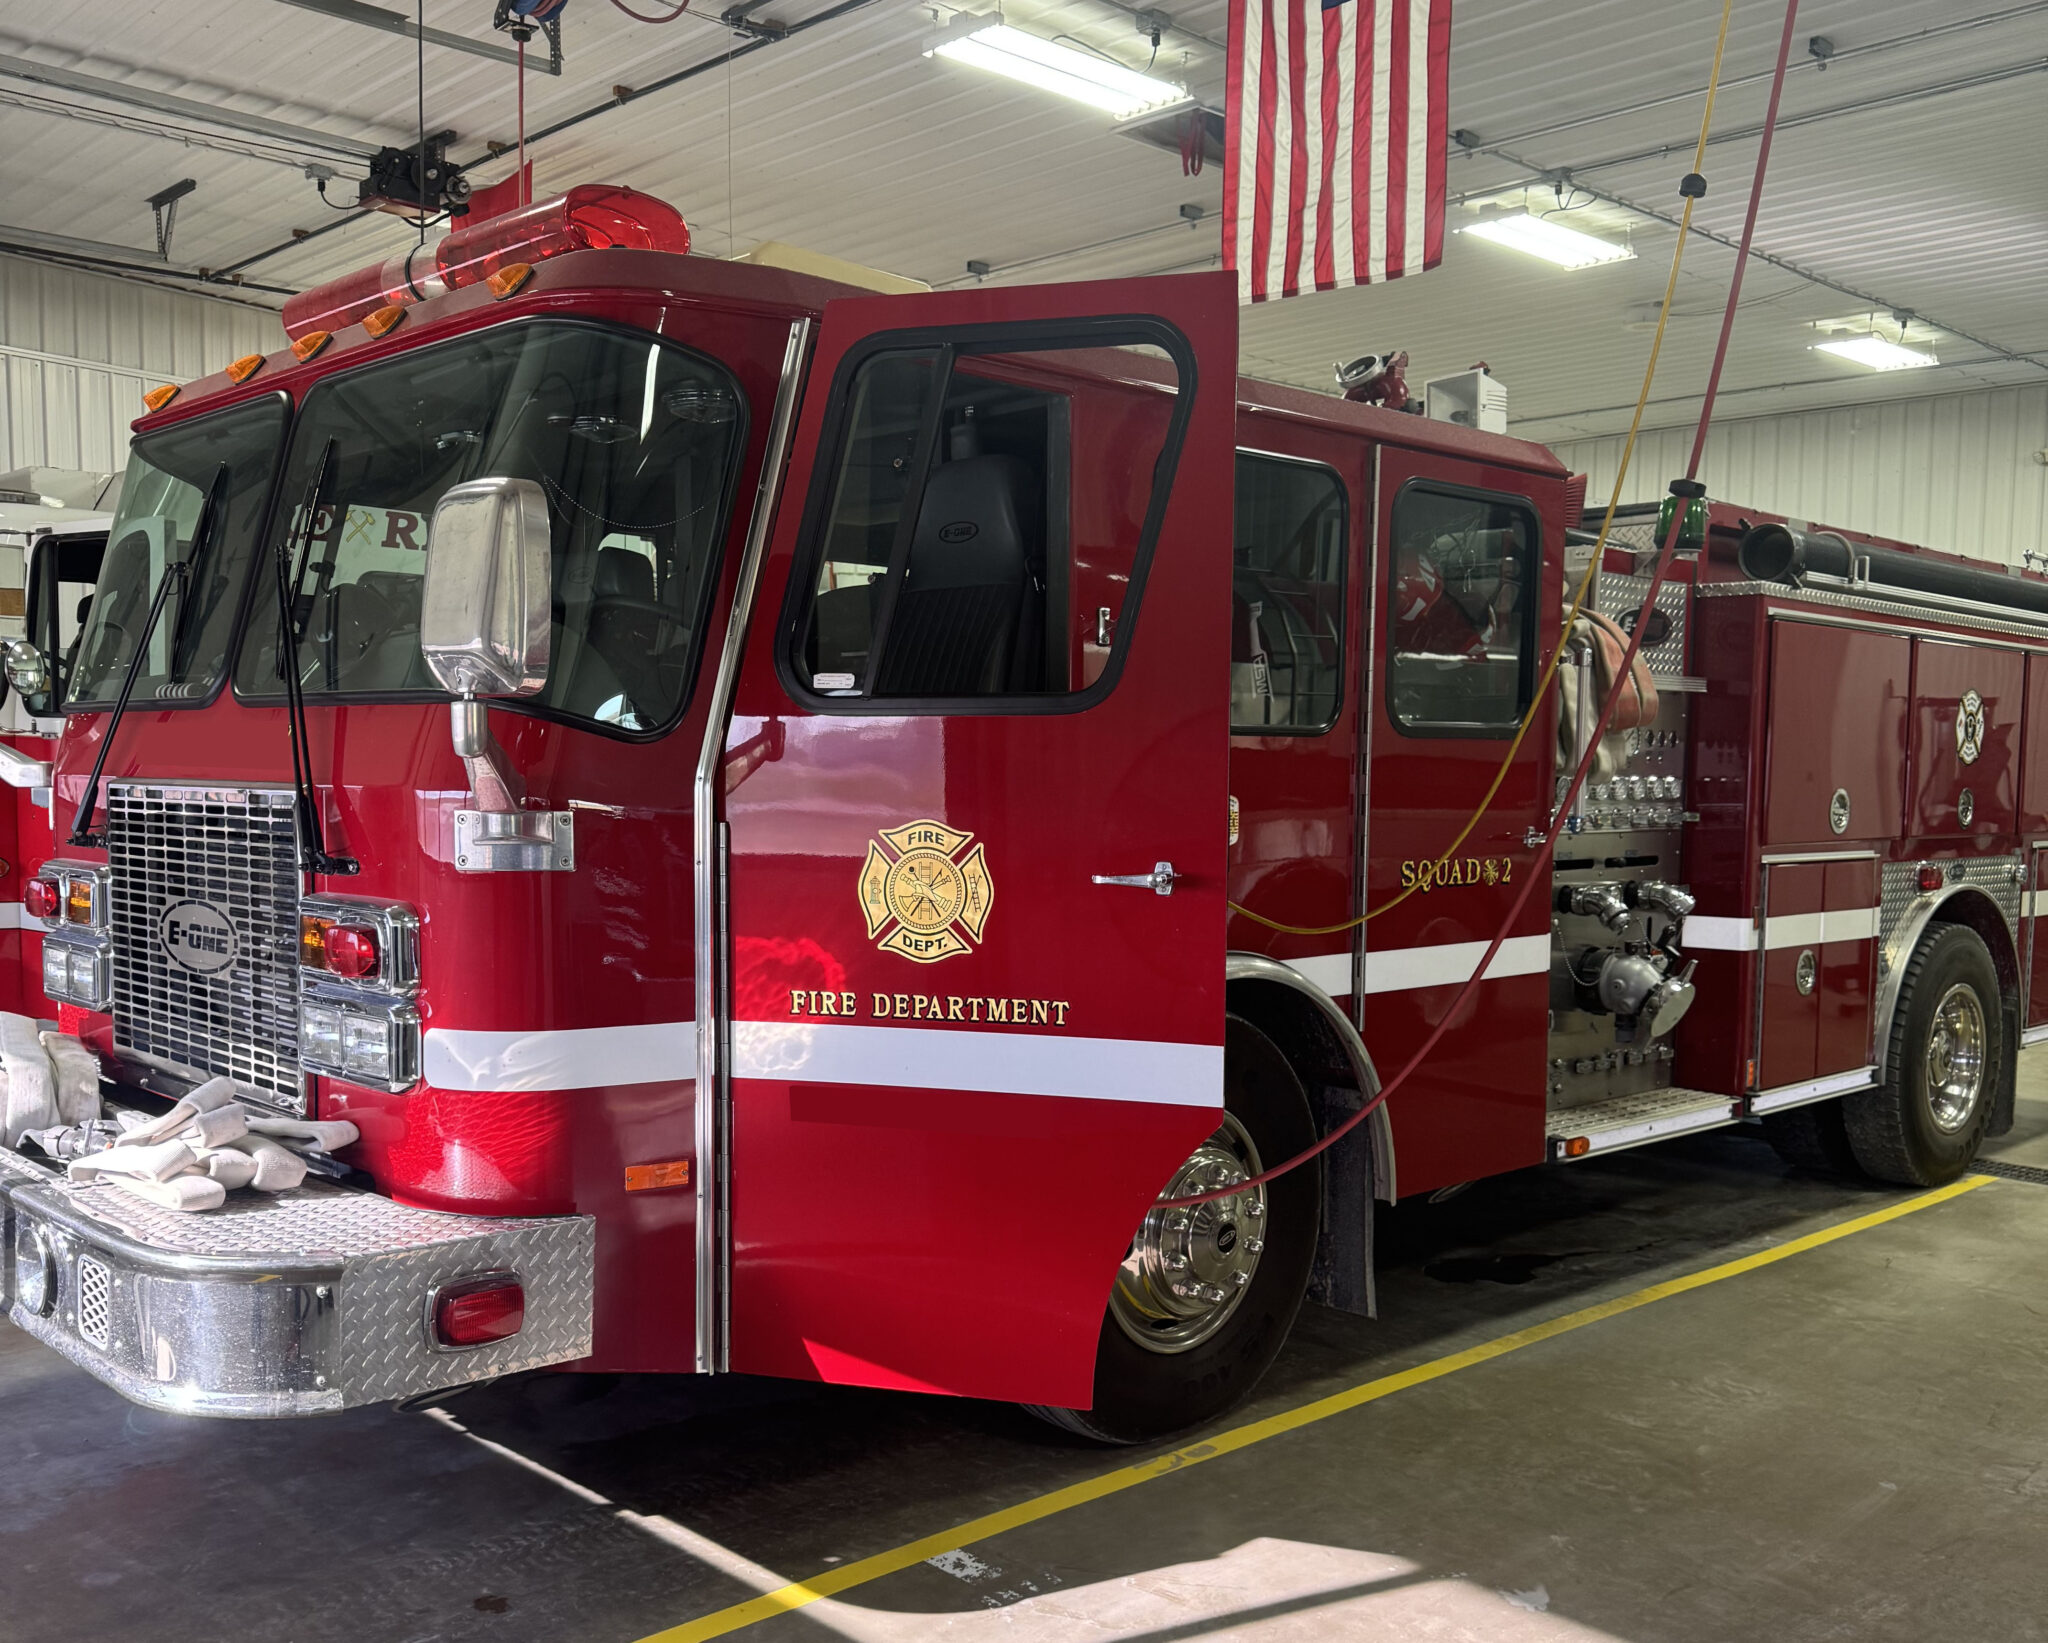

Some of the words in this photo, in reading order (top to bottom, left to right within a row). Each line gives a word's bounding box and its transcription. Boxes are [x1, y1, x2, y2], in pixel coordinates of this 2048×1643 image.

[381, 511, 427, 551] R
[1254, 655, 1268, 695] MSA
[907, 830, 945, 847] FIRE
[1401, 858, 1481, 891] SQUAD
[1501, 857, 1512, 885] 2
[168, 919, 229, 955] E-ONE
[902, 933, 948, 952] DEPT.
[790, 989, 857, 1016] FIRE
[871, 992, 1070, 1026] DEPARTMENT
